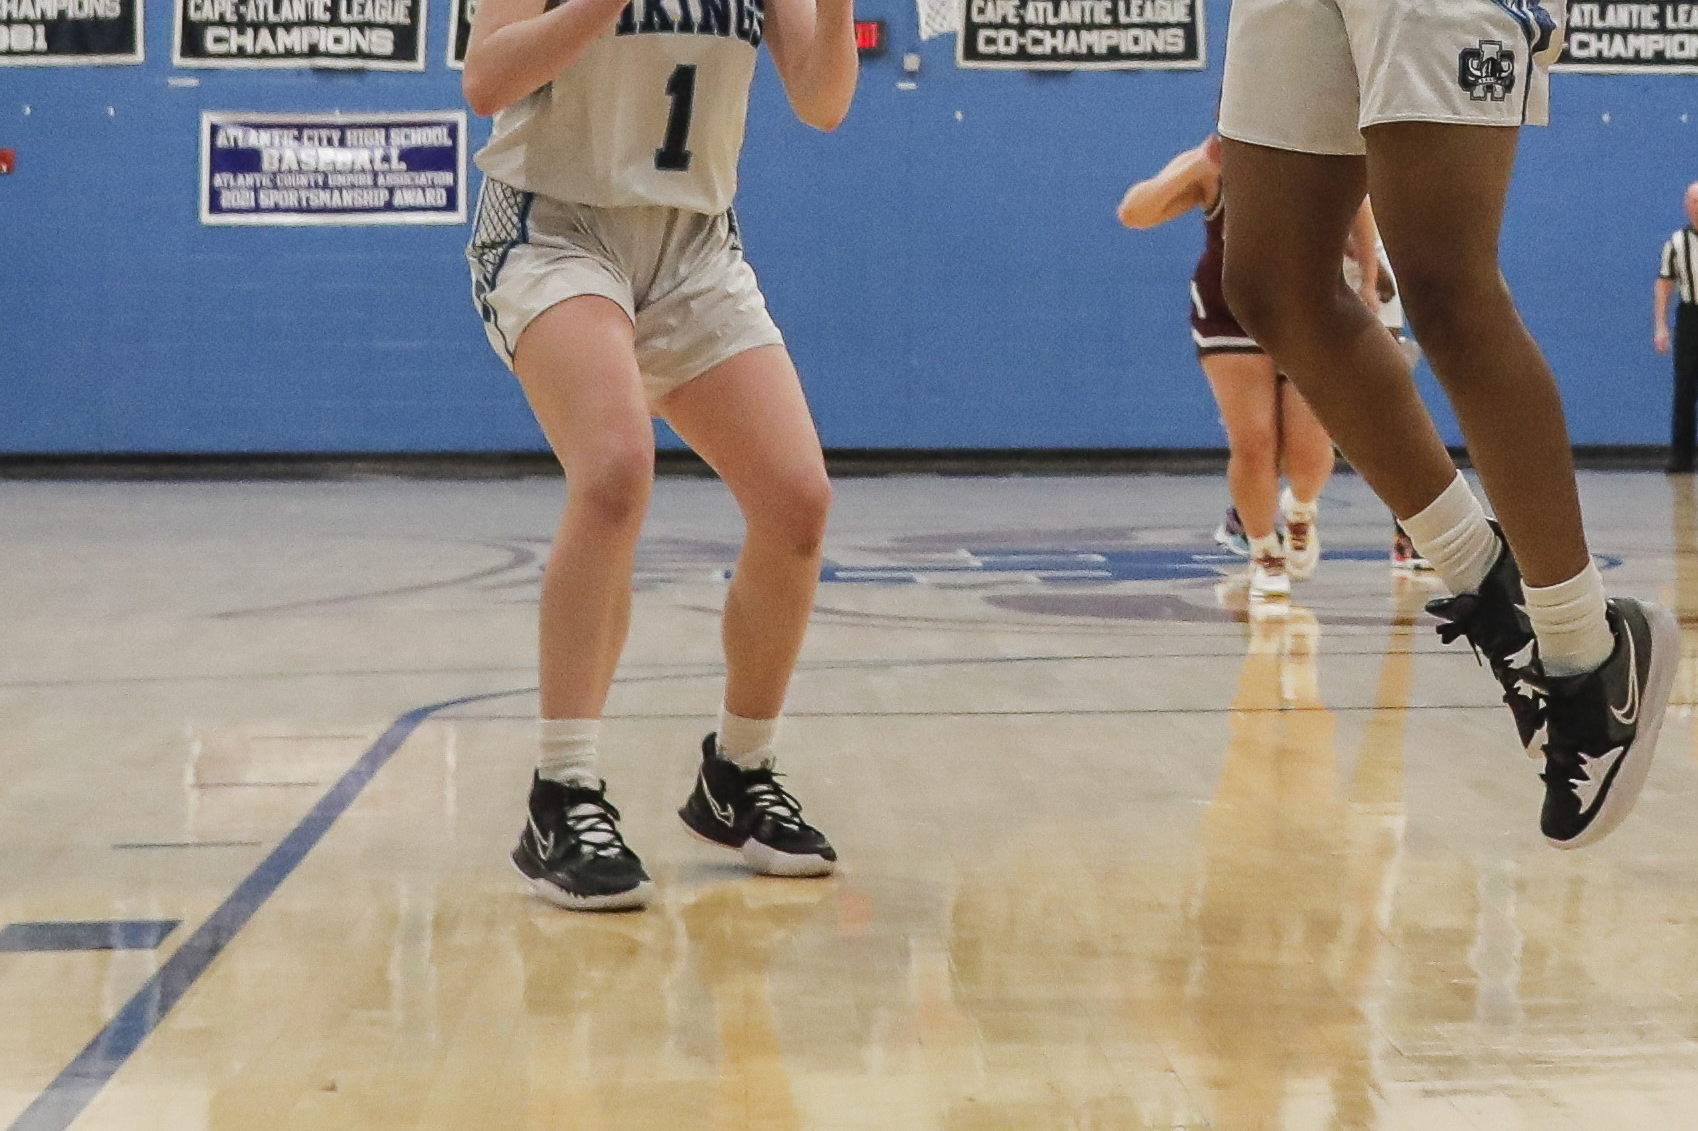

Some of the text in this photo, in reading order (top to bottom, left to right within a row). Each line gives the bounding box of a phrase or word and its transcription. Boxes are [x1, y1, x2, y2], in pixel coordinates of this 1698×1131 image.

[205, 25, 394, 55] CHAMPIONS
[976, 28, 1186, 55] CO-CHAMPIONS
[653, 63, 698, 172] 1
[216, 126, 299, 149] ATLANTIC
[302, 127, 342, 148] CITY
[390, 126, 453, 148] SCHOOL
[259, 188, 390, 208] SPORTSMANSHIP
[393, 188, 448, 208] AWARD
